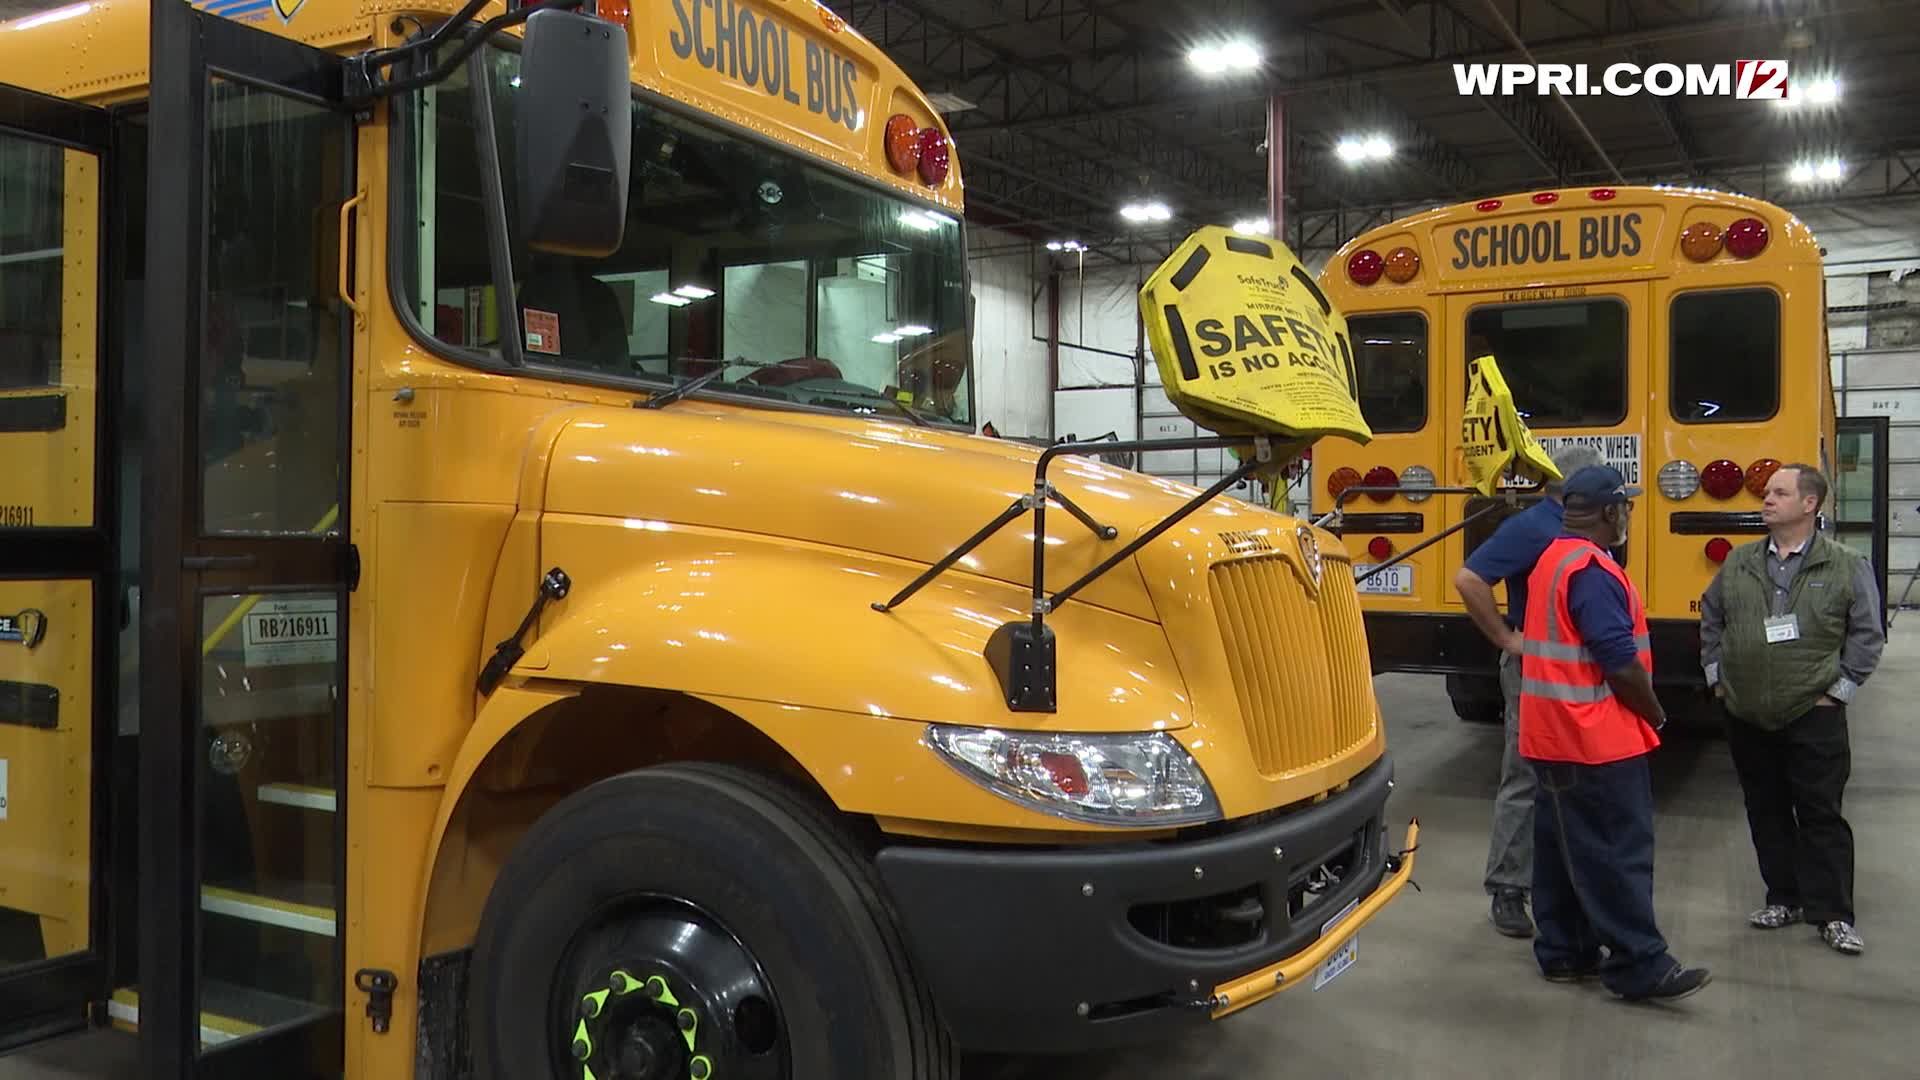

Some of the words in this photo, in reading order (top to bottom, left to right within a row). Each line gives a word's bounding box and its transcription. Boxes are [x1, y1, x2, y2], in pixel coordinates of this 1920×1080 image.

[670, 0, 801, 105] SCHOOL
[805, 39, 858, 131] BUS
[1452, 219, 1571, 270] SCHOOL
[1579, 212, 1642, 260] BUS
[1195, 314, 1341, 376] SAFETY
[1209, 360, 1236, 380] IS
[1242, 351, 1280, 373] NO
[1463, 417, 1493, 442] ETY
[1605, 435, 1638, 459] WHEN
[1367, 571, 1399, 587] 8610
[259, 615, 329, 639] RB216911
